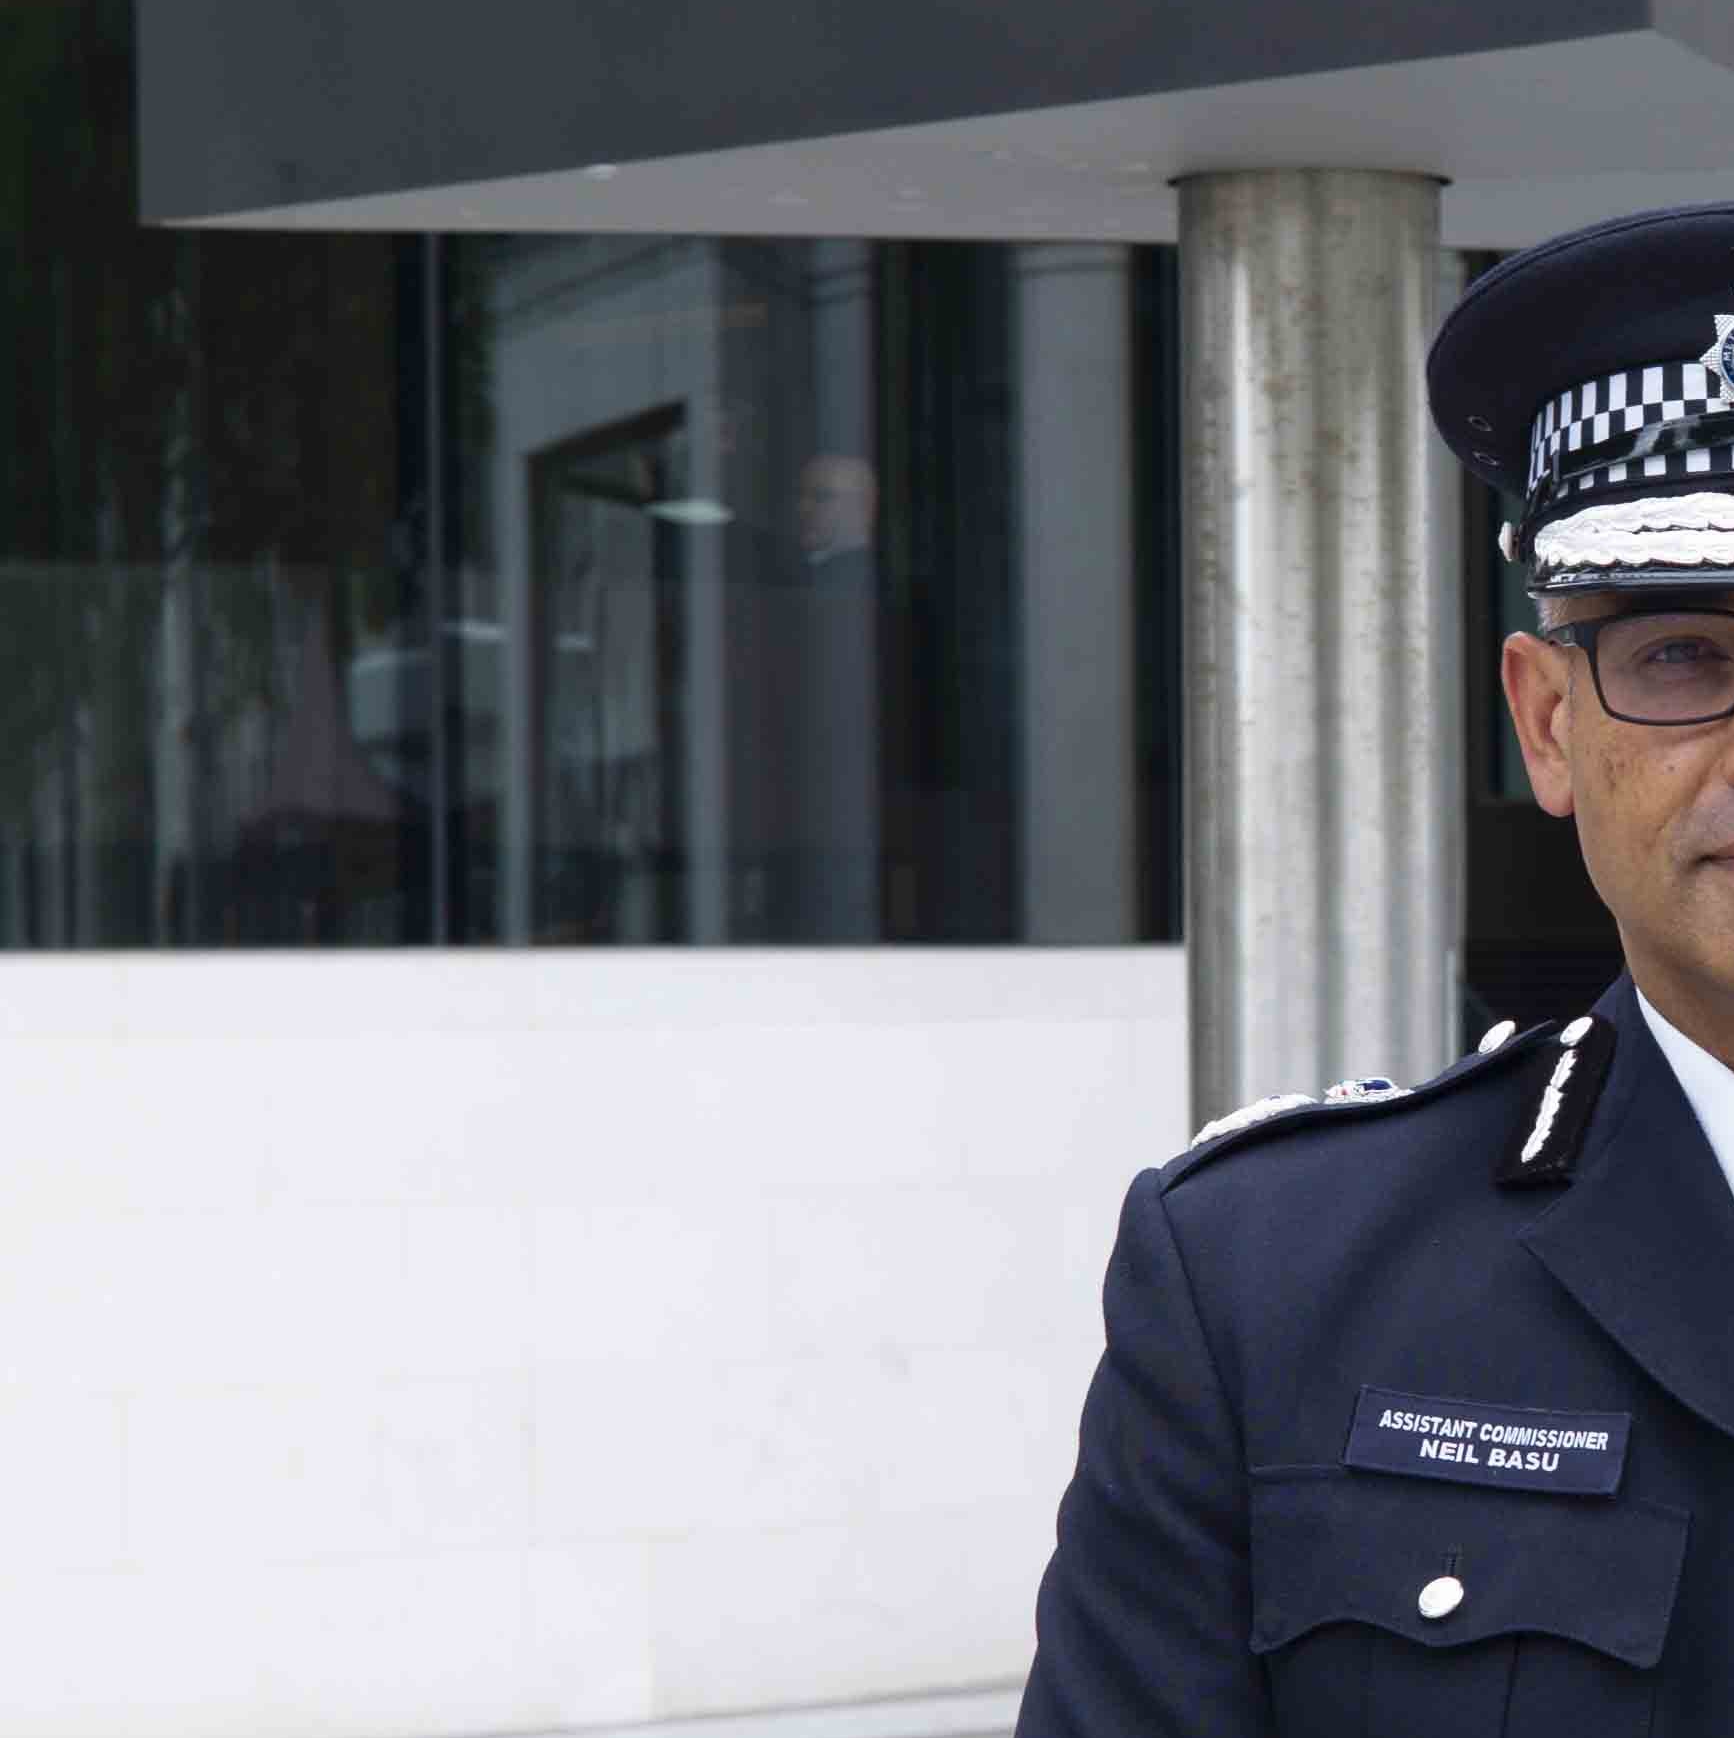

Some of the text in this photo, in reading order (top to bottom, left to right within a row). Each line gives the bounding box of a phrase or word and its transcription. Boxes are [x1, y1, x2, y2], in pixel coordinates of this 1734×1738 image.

[1379, 1409, 1608, 1451] ASSISTANT COMMISSIONER
[1420, 1439, 1560, 1472] NEIL BASU
